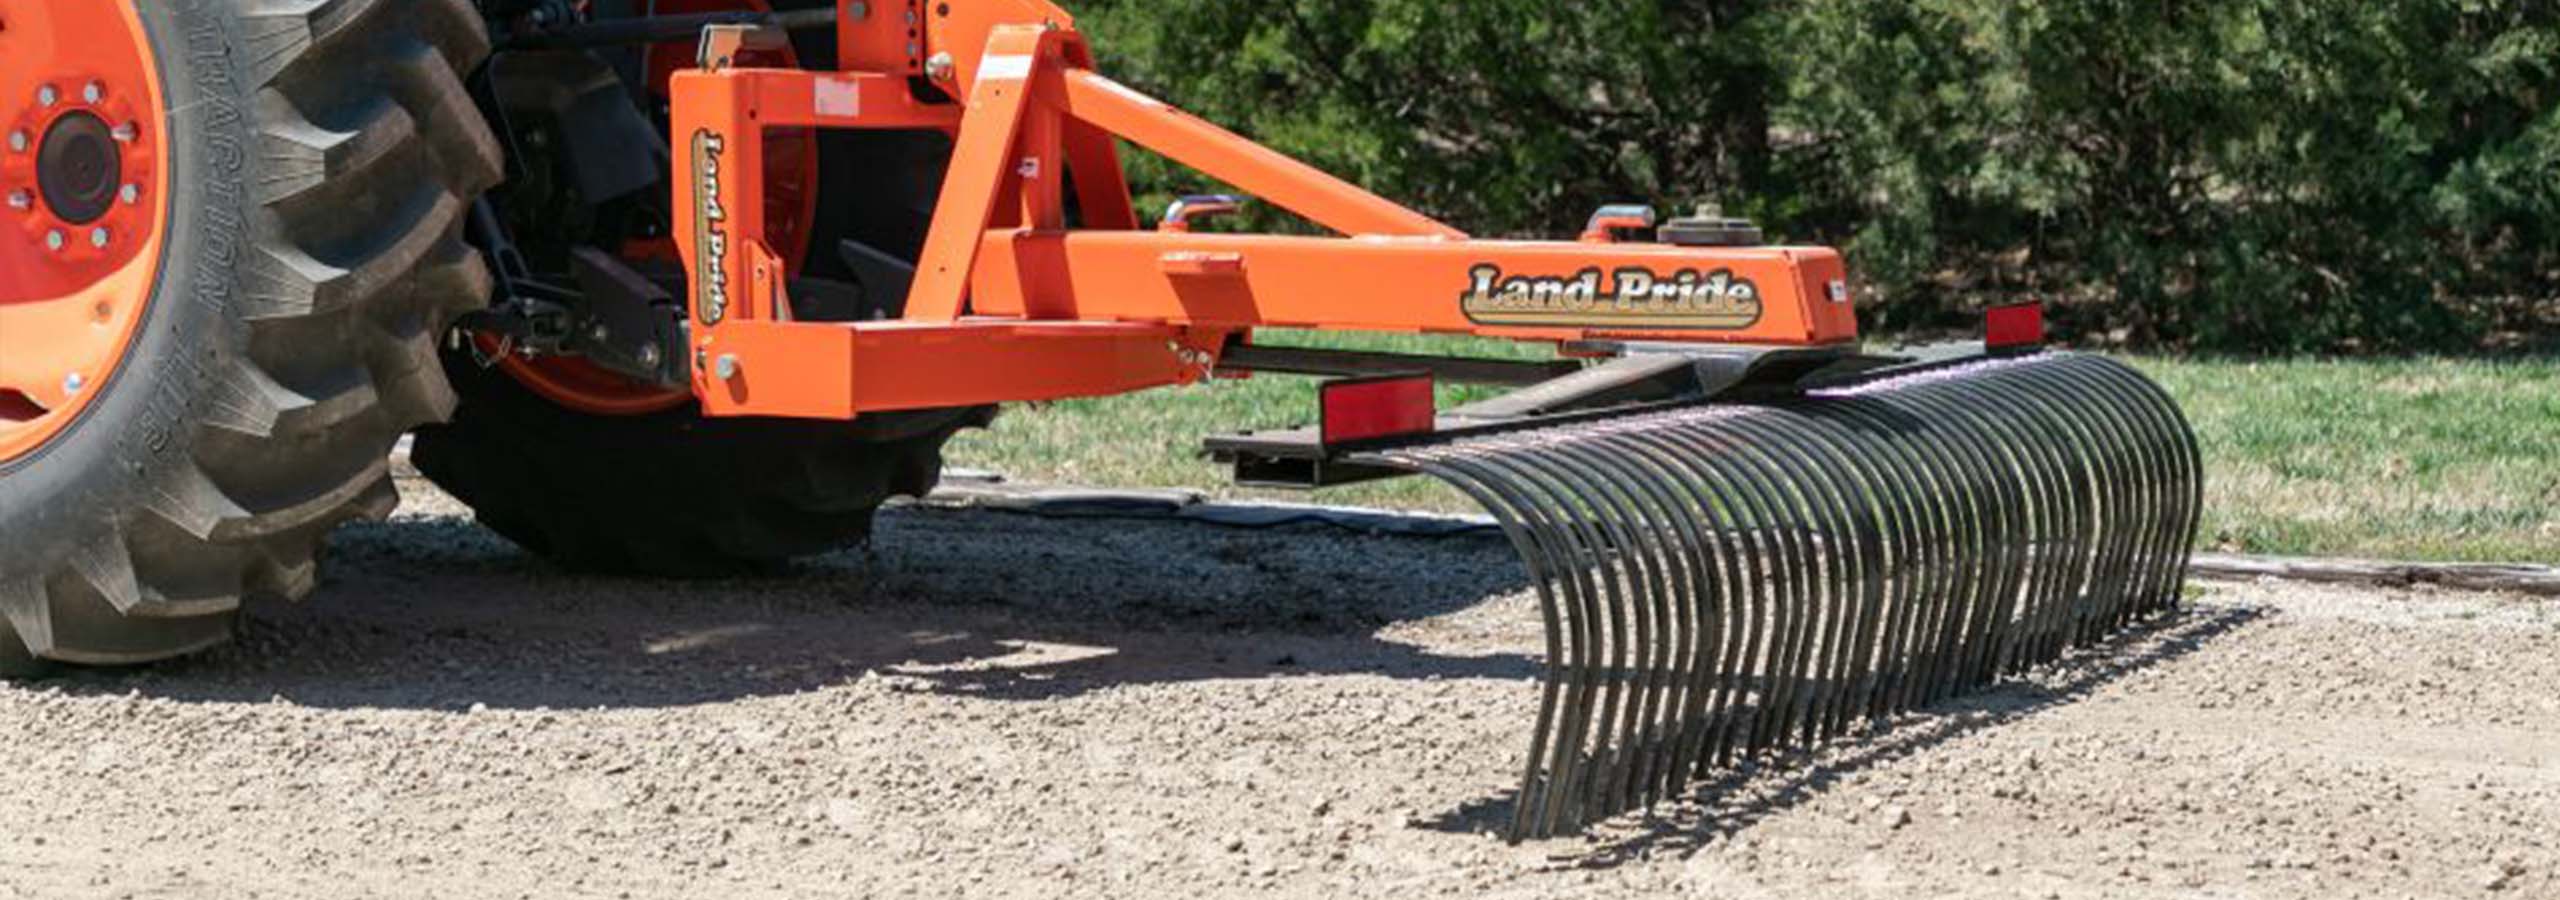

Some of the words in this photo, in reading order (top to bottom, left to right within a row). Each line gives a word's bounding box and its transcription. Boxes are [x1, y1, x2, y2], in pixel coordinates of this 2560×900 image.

[702, 134, 726, 221] Land
[704, 231, 728, 322] Pride
[1470, 265, 1600, 312] Land
[1612, 267, 1756, 314] Pride
